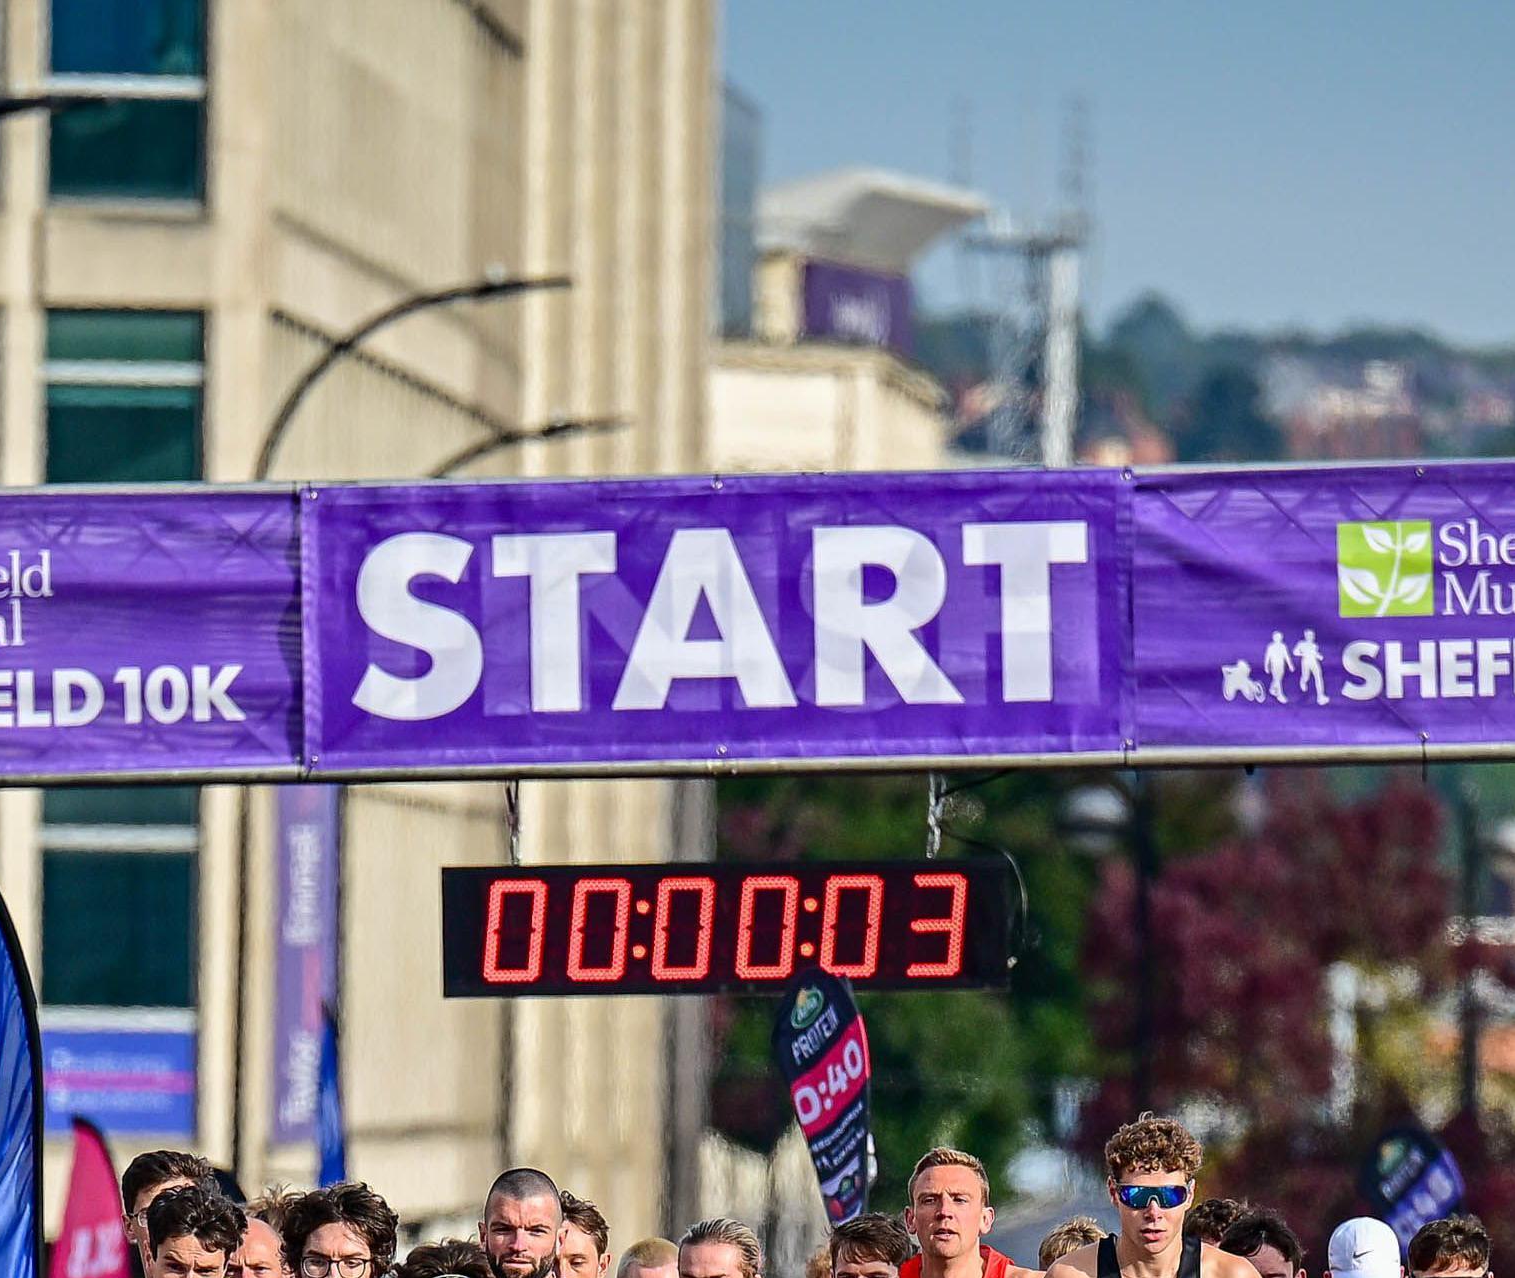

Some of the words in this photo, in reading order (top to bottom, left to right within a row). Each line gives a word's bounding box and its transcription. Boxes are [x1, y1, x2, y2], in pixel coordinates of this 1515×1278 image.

[352, 519, 1088, 720] START
[120, 664, 245, 725] 10K
[484, 873, 968, 982] 00:00:03
[791, 1004, 840, 1066] PROTEIN
[793, 1038, 864, 1127] 0:40
